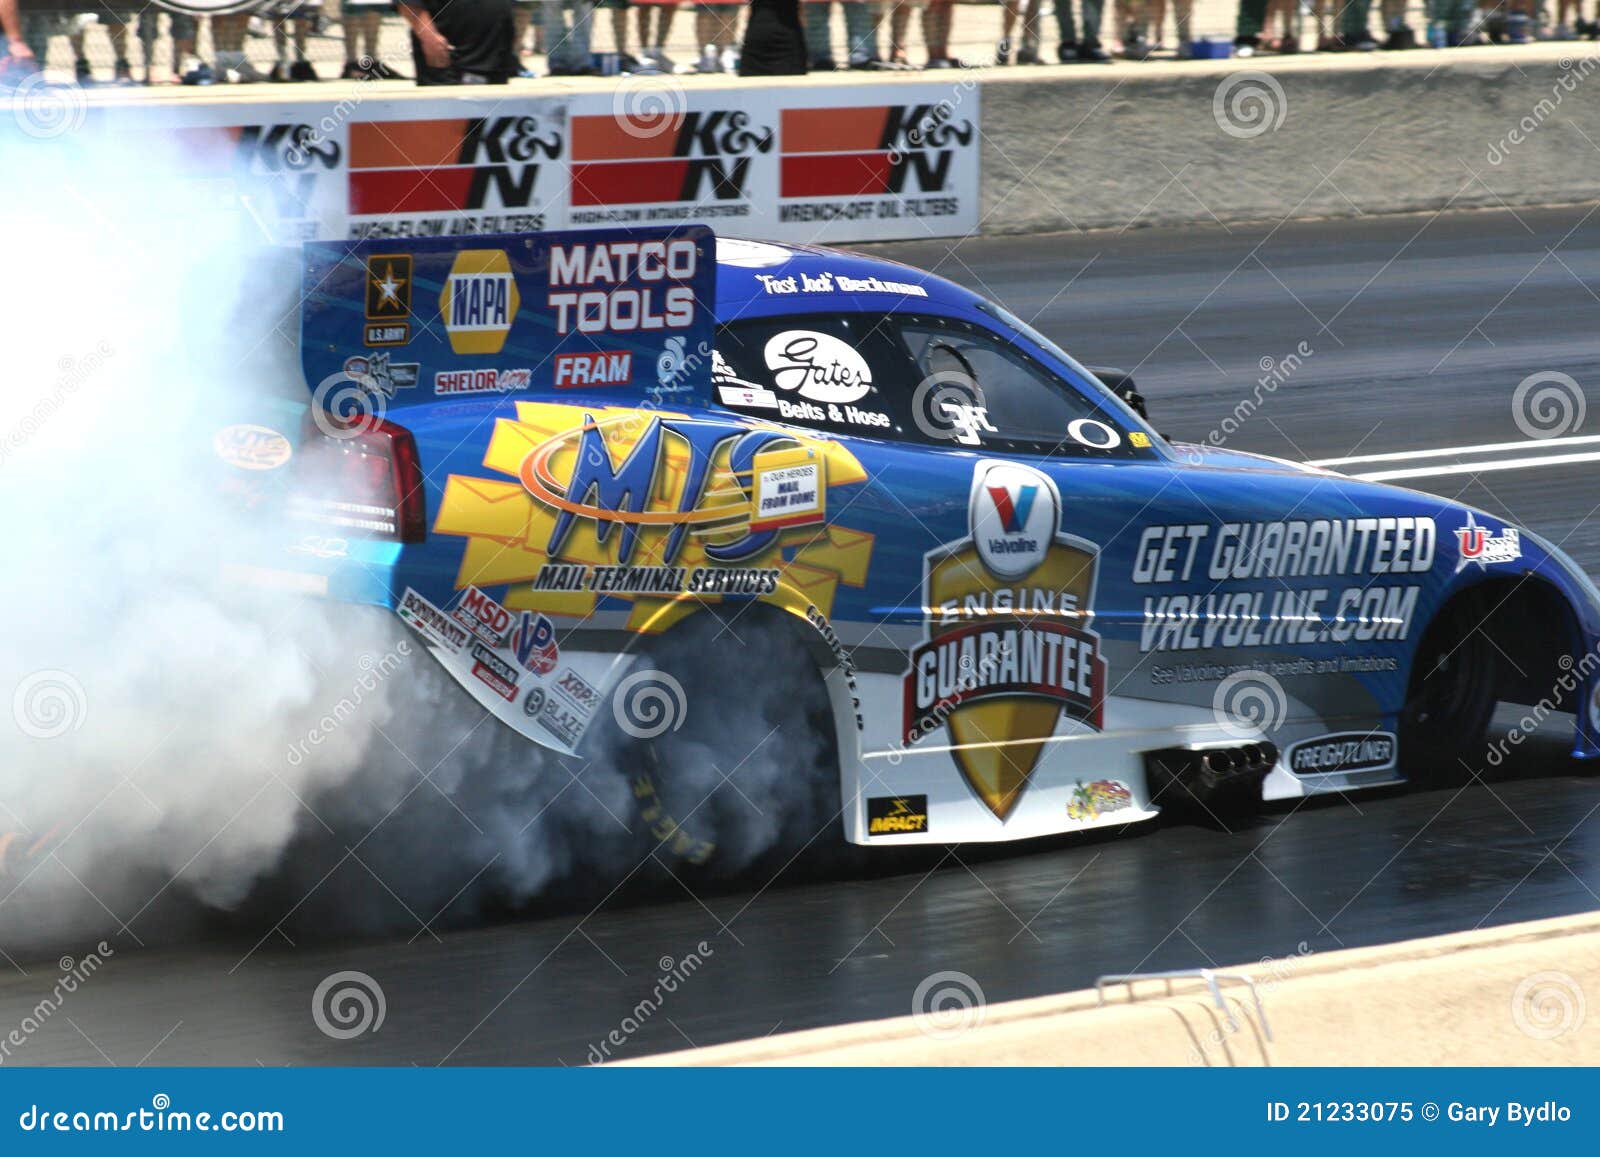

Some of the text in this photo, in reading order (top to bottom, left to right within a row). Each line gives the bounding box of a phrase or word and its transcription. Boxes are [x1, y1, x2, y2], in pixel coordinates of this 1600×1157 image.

[458, 116, 562, 164] K&
[672, 110, 774, 157] K&
[465, 163, 539, 211] N
[680, 156, 752, 201] N
[886, 150, 953, 194] N
[449, 217, 481, 237] AIR
[482, 213, 547, 235] FILTERS
[571, 209, 641, 225] HIGH-FLOW
[693, 203, 750, 219] SYSTEMS
[779, 204, 876, 223] WRENCH-OFF
[878, 202, 905, 219] OIL
[549, 240, 697, 286] MATCO
[453, 278, 507, 326] NAPA
[548, 288, 695, 335] TOOLS
[555, 354, 630, 387] FRAM
[771, 337, 878, 394] Gates
[777, 399, 891, 429] Belts & Hose
[989, 538, 1038, 555] Valvoline
[1131, 524, 1209, 585] GET
[1208, 517, 1437, 581] GUARANTEED
[533, 565, 780, 595] MAIL TERMINAL SERVICES
[462, 588, 510, 633] MSD
[939, 588, 1081, 627] ENGINE
[1139, 585, 1421, 653] VALVOLINE.COM
[475, 646, 517, 684] LINCOLN
[916, 629, 1093, 709] GUARANTEE
[1294, 741, 1391, 770] FREIGHTLINER
[870, 815, 926, 833] IMPACT
